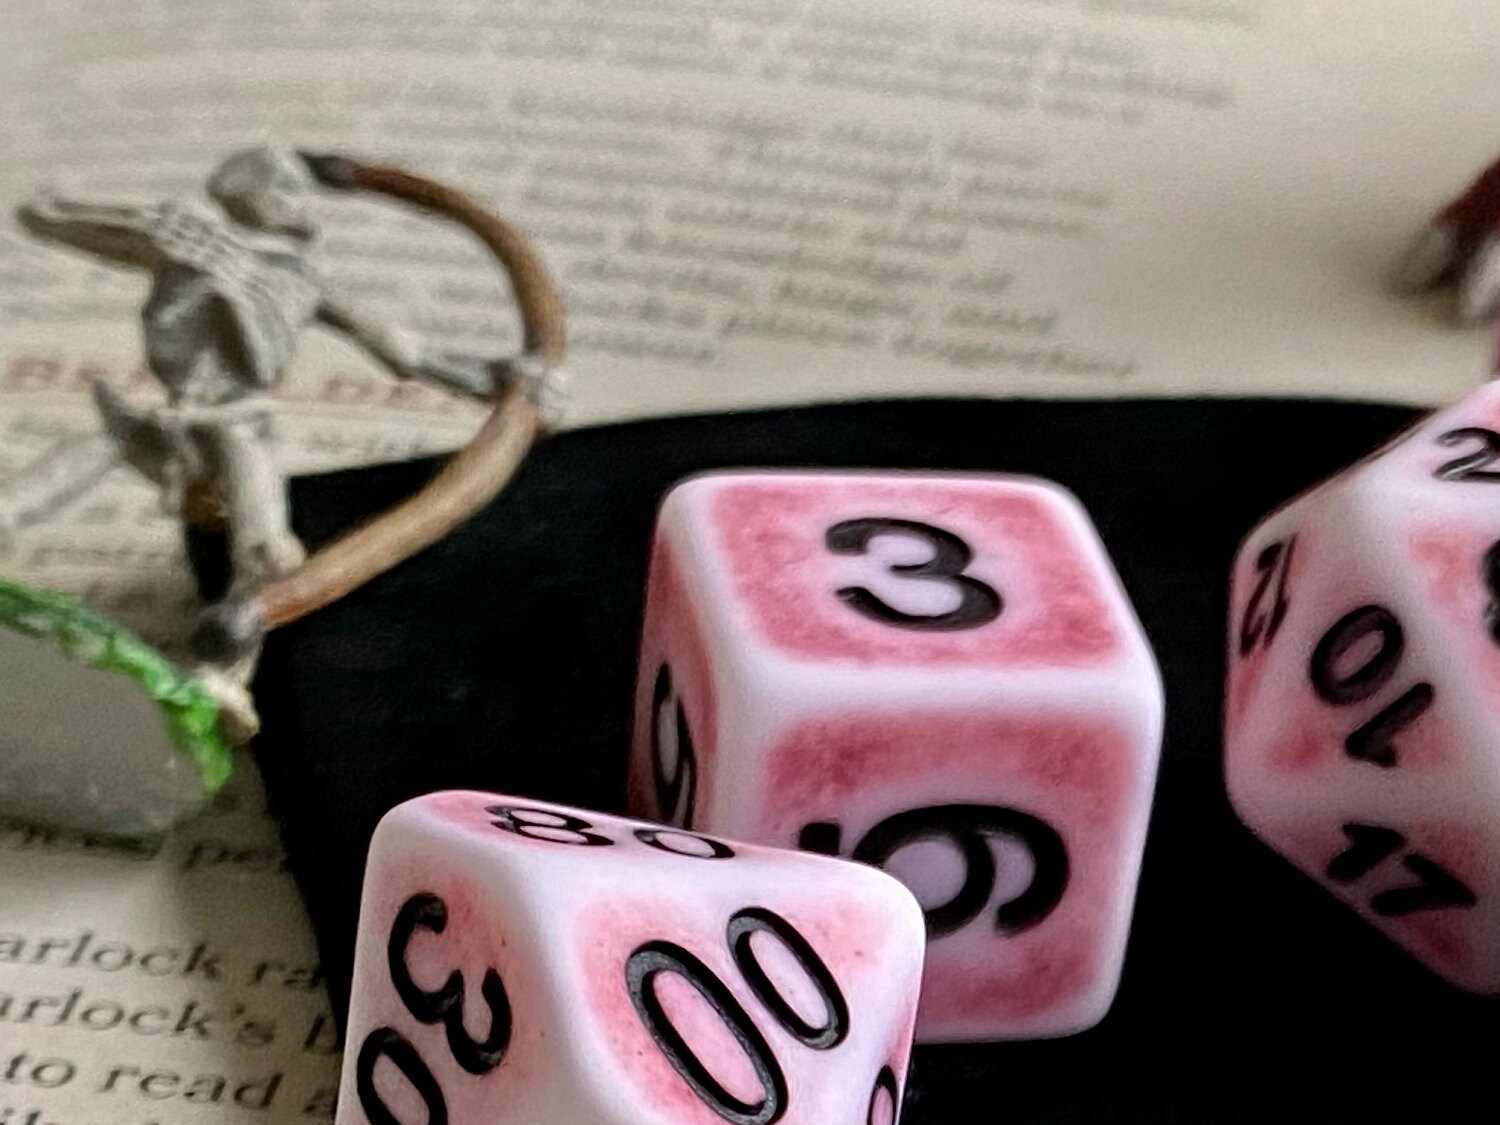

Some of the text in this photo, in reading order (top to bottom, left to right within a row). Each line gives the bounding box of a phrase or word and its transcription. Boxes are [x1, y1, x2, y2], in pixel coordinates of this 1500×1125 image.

[825, 517, 1002, 631] 3
[1310, 604, 1434, 768] 10
[3, 1052, 77, 1088] to
[96, 1071, 283, 1111] read
